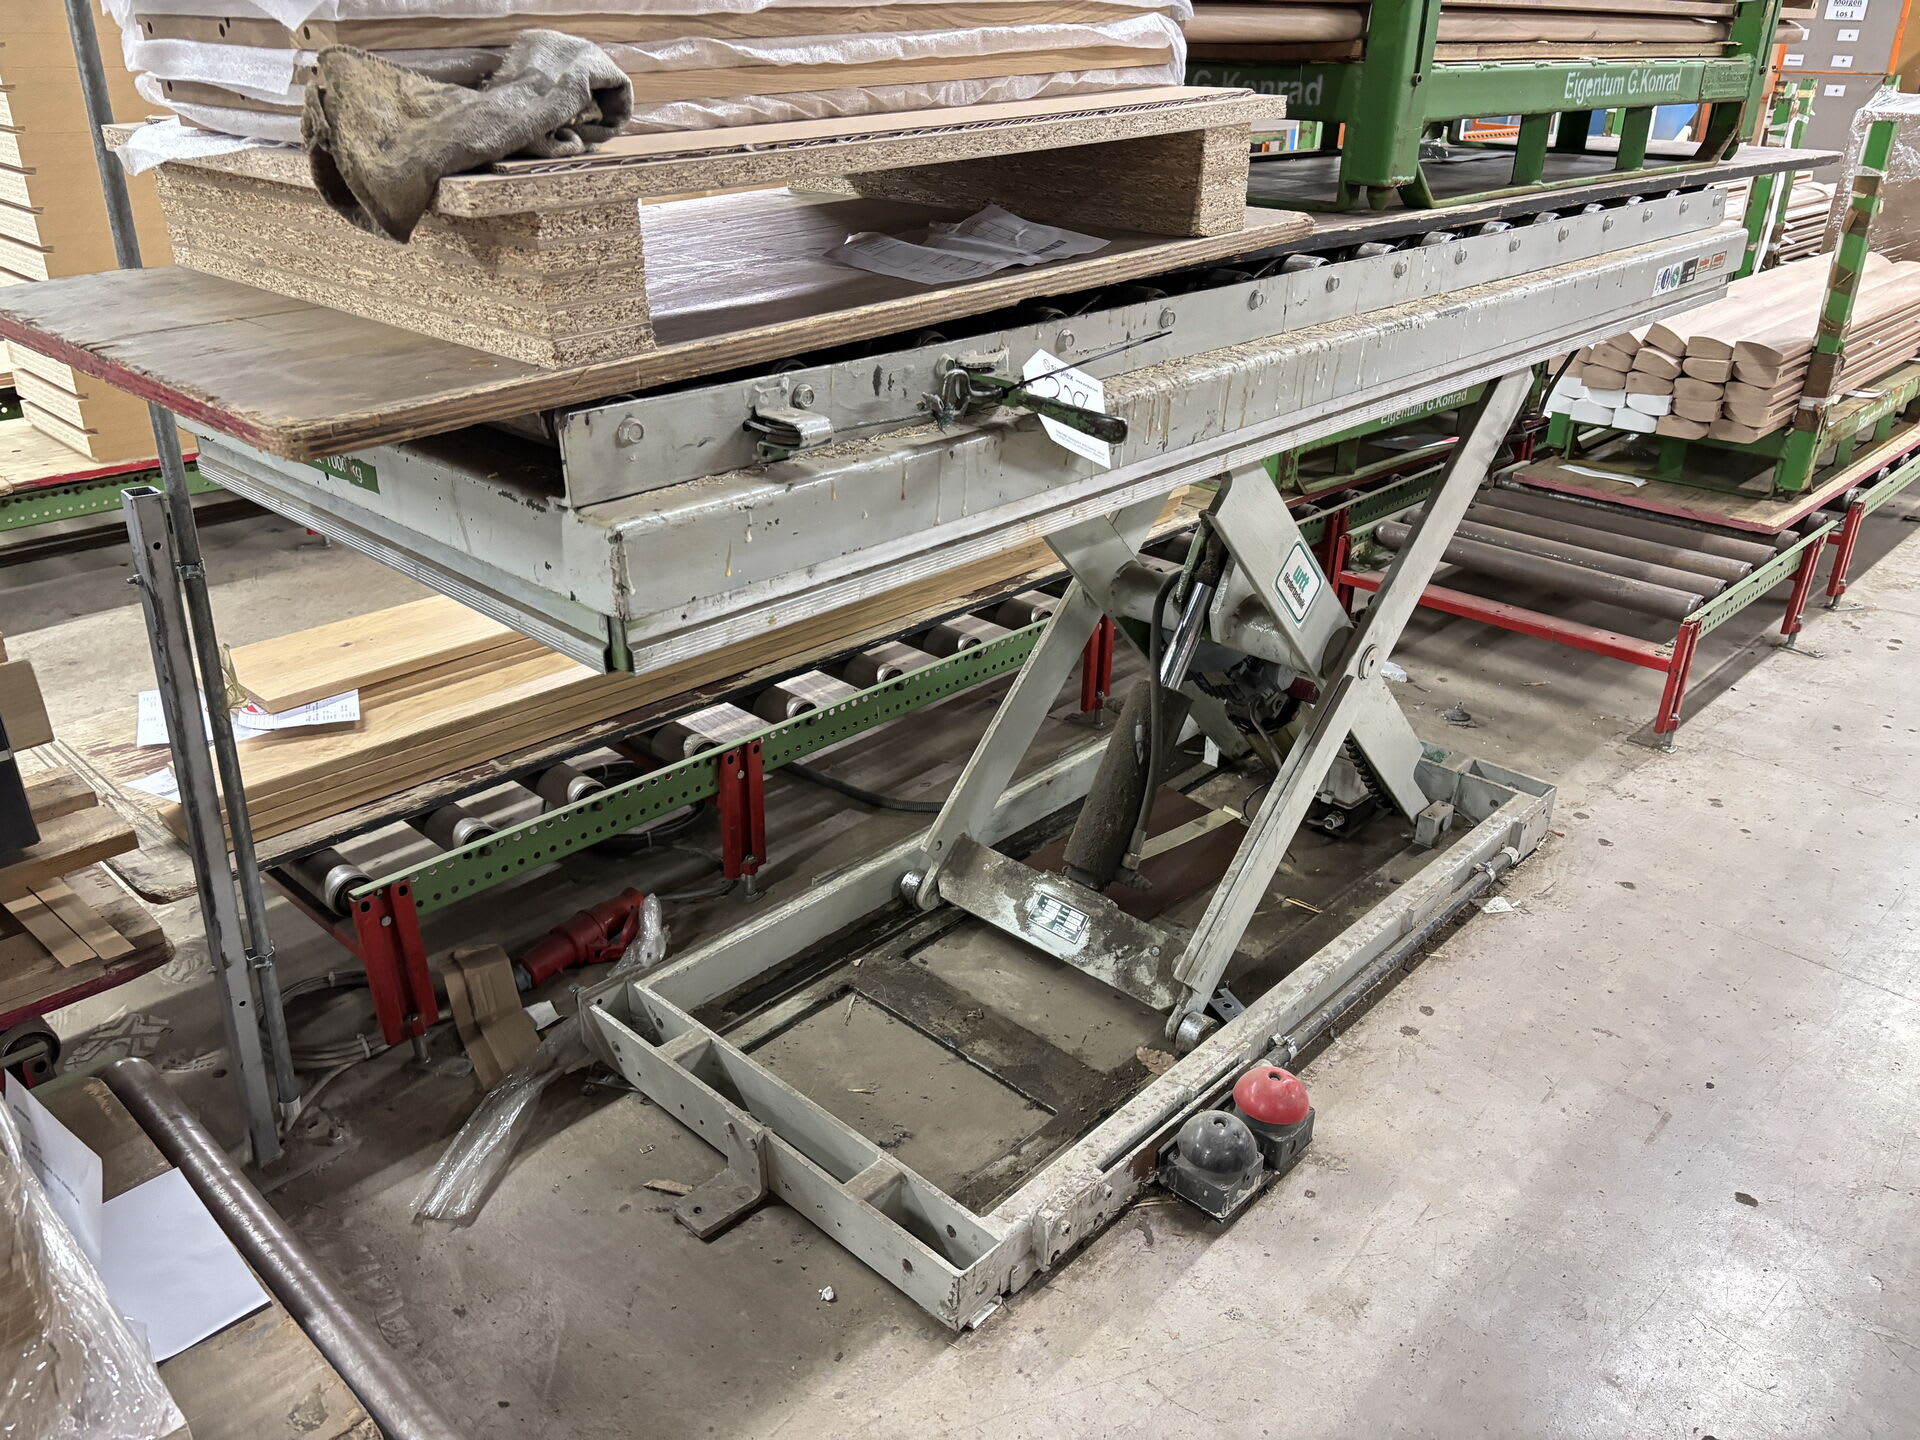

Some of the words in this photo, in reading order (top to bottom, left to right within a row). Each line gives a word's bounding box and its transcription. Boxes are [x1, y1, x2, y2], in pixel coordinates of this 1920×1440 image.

[1835, 10, 1848, 18] Los
[1563, 70, 1624, 104] Eigentum
[1627, 67, 1682, 95] G.Konrad
[1426, 389, 1468, 411] G.Konrad
